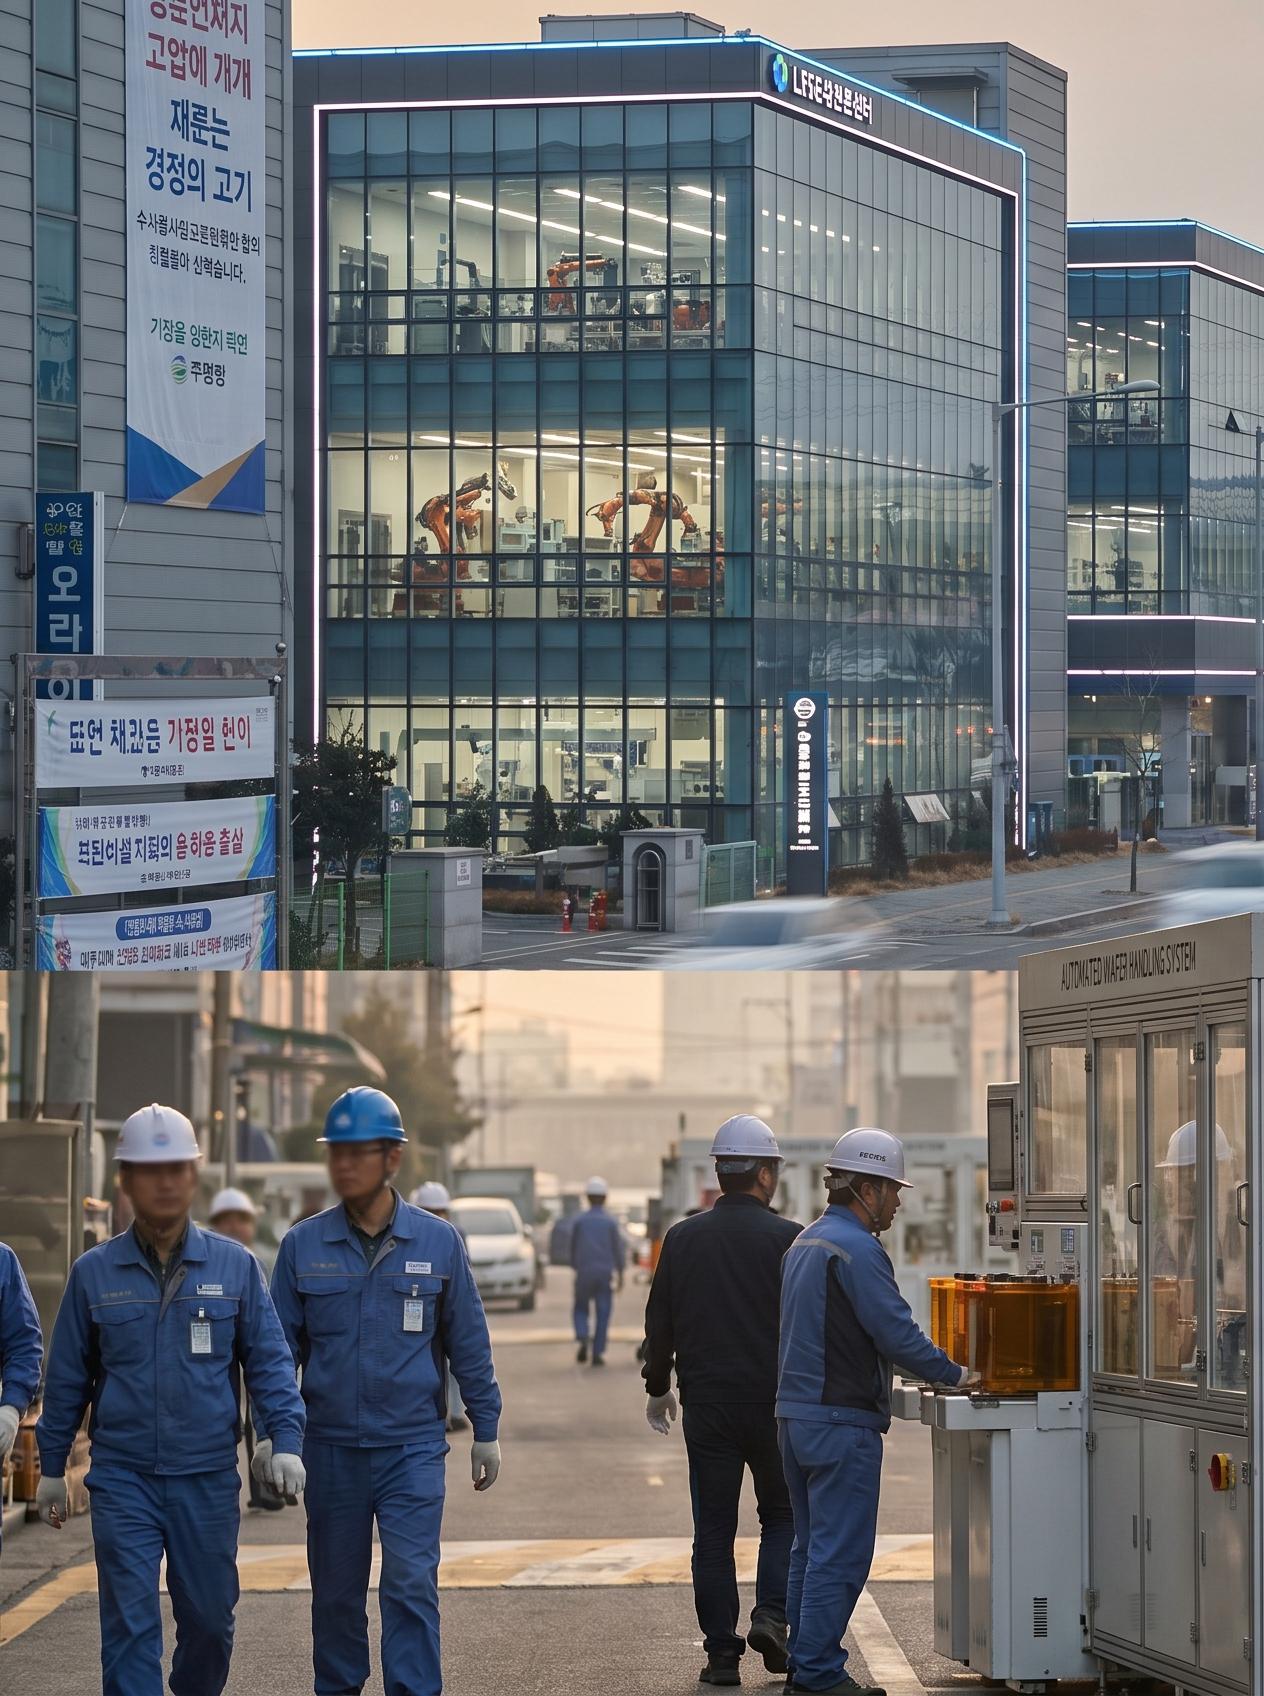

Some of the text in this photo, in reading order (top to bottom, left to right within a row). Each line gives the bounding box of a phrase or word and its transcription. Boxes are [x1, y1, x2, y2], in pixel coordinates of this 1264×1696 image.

[145, 145, 252, 213] 경정의 고기
[1061, 941, 1196, 991] AUTOMATED WAFER HANDLING SYSTEM
